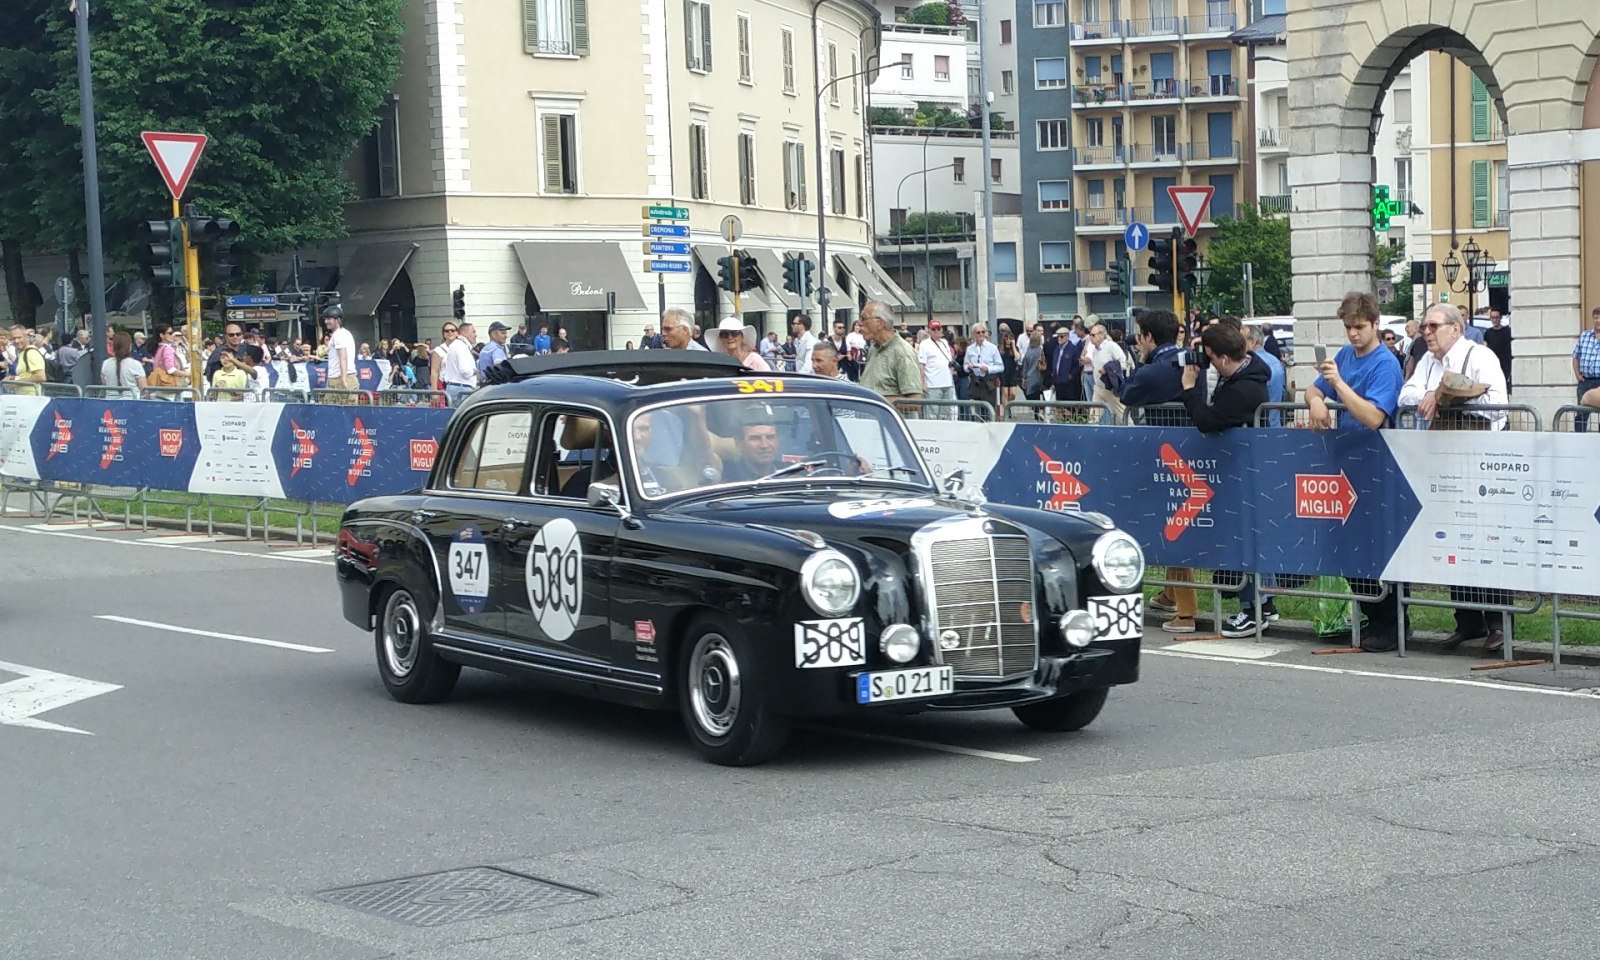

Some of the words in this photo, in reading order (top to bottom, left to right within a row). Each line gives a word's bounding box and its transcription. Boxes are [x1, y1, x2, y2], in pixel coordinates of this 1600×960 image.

[650, 226, 675, 234] CREMONA
[651, 244, 675, 252] MANTOVA
[732, 379, 784, 393] 347
[293, 429, 316, 440] 1000
[292, 444, 315, 454] MIGLIA
[413, 443, 433, 454] 1000
[292, 458, 313, 469] 2018
[413, 457, 435, 468] MIGLI
[1040, 460, 1082, 475] 1000
[1155, 459, 1184, 468] THE
[1188, 459, 1217, 469] MOST
[1480, 462, 1530, 472] CHOPARD
[1153, 472, 1222, 484] BEAUTIFUL
[1036, 480, 1083, 496] MIGLIA
[1169, 487, 1208, 498] RACE
[1302, 479, 1339, 495] 1000
[1167, 502, 1178, 511] IN
[1181, 502, 1211, 513] THE
[1299, 499, 1344, 514] MIGLIA
[1165, 516, 1214, 528] WORLD
[455, 550, 482, 580] 347
[532, 544, 578, 615] 589
[803, 621, 861, 665] 589
